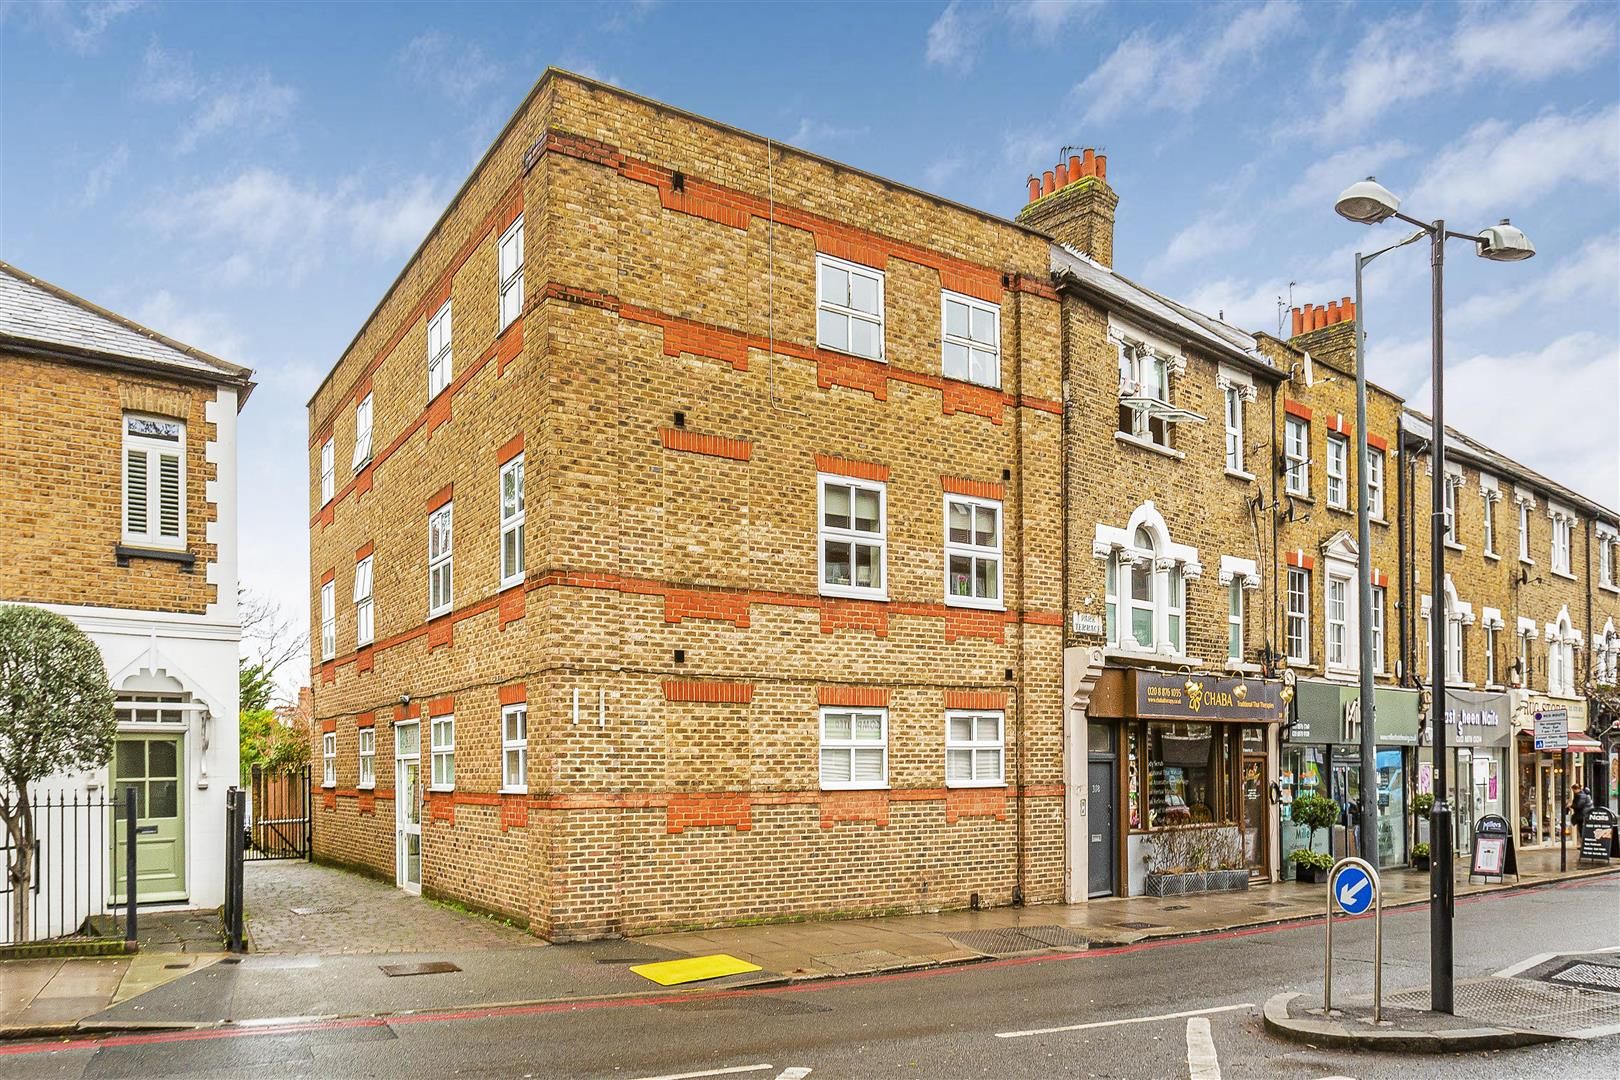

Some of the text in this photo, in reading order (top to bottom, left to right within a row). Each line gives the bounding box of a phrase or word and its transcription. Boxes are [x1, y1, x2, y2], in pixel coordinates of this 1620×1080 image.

[1204, 691, 1233, 706] CHABA
[1542, 703, 1566, 711] STO
[1445, 709, 1456, 724] ast
[1481, 710, 1499, 726] Nails
